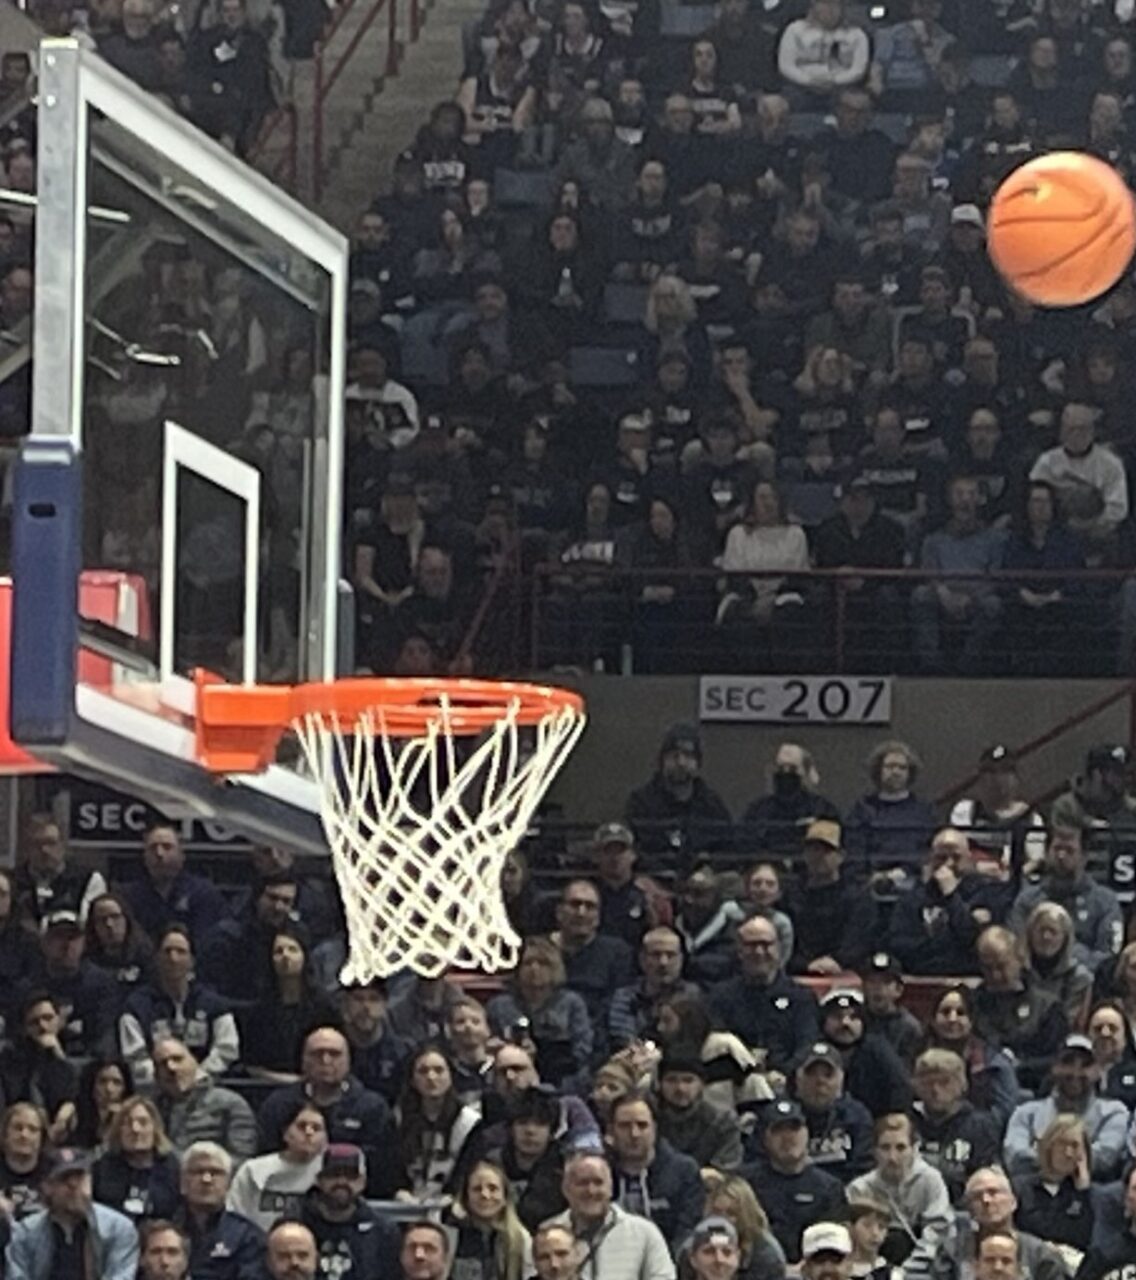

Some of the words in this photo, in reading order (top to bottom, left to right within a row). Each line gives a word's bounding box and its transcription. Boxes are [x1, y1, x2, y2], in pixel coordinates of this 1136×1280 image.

[705, 686, 766, 712] SEC
[781, 680, 884, 718] 207
[78, 803, 147, 831] SEC
